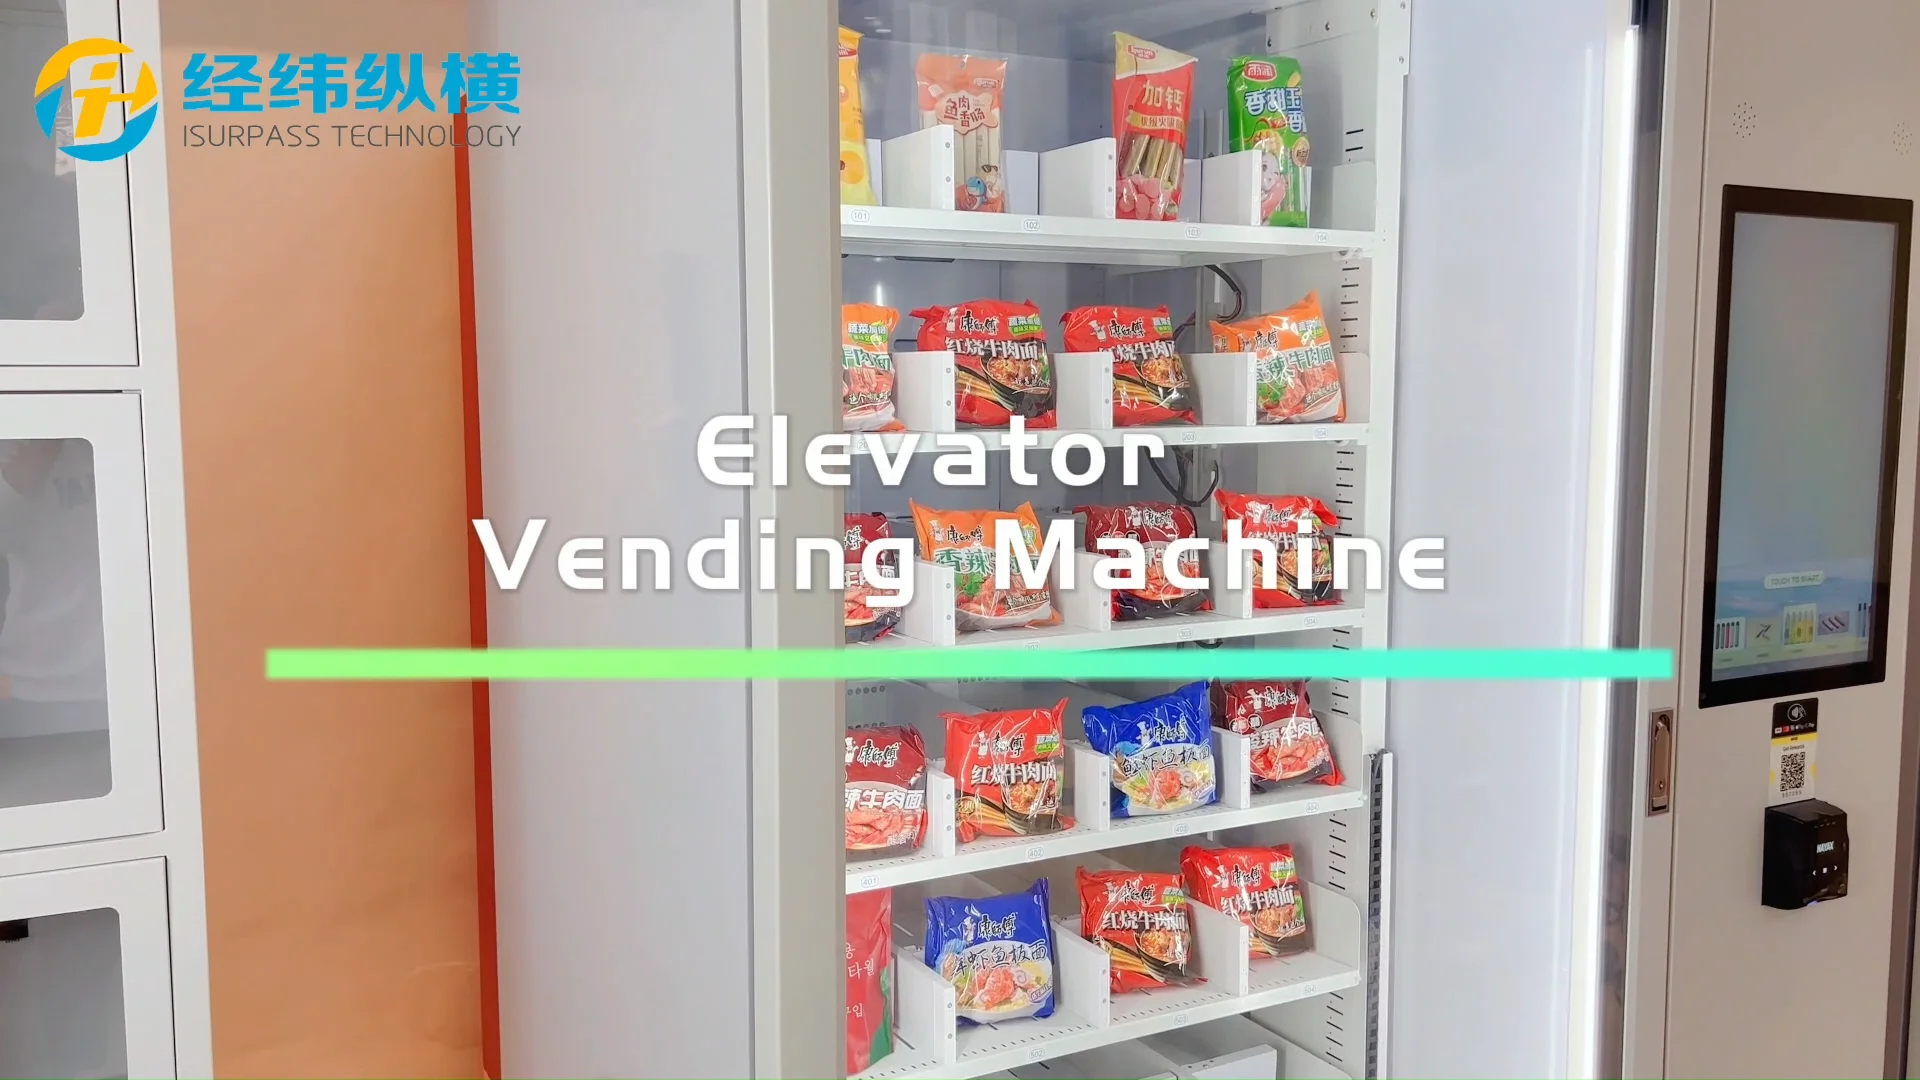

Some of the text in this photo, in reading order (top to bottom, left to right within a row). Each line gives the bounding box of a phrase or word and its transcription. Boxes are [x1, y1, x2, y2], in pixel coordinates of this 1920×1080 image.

[1141, 79, 1185, 114] 加钙
[1244, 86, 1303, 116] 香甜玉
[847, 957, 875, 980] 타월
